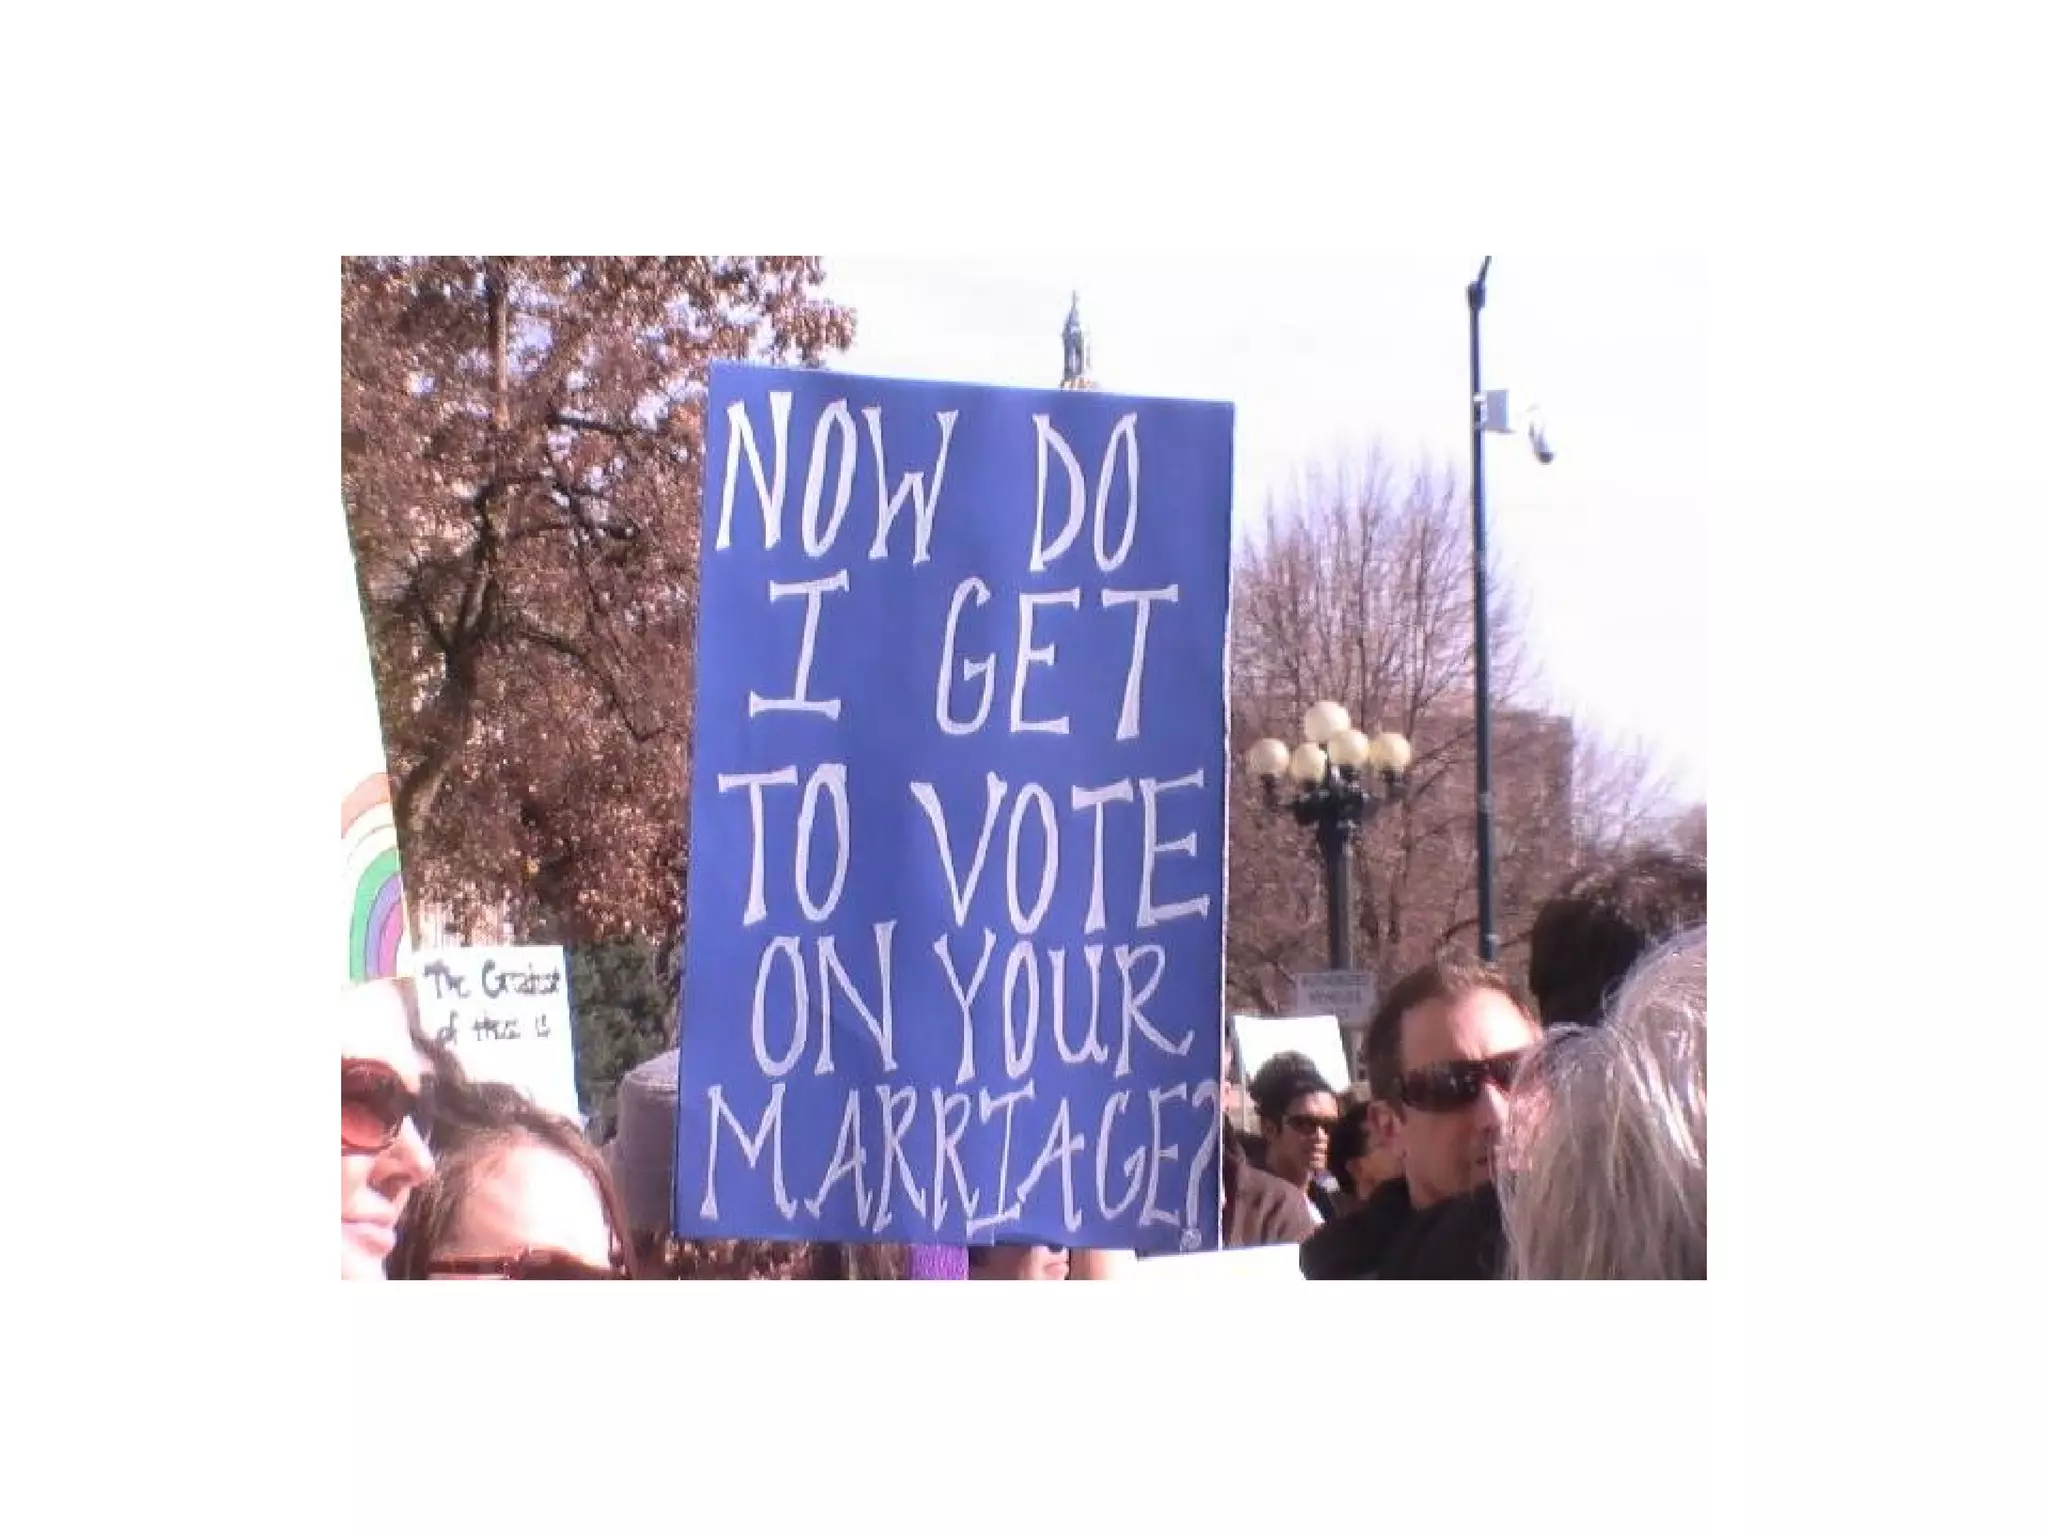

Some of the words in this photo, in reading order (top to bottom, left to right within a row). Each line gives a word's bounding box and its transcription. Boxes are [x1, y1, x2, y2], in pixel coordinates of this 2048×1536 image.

[716, 391, 958, 564] NOW
[1032, 412, 1139, 572] DO
[749, 569, 850, 720] I
[935, 577, 1180, 740] GET
[718, 763, 849, 926] TO
[910, 769, 1210, 934] VOTE
[752, 920, 898, 1077] ON
[933, 928, 1196, 1084] YOUR
[700, 1079, 1222, 1249] MARRIAGE?
